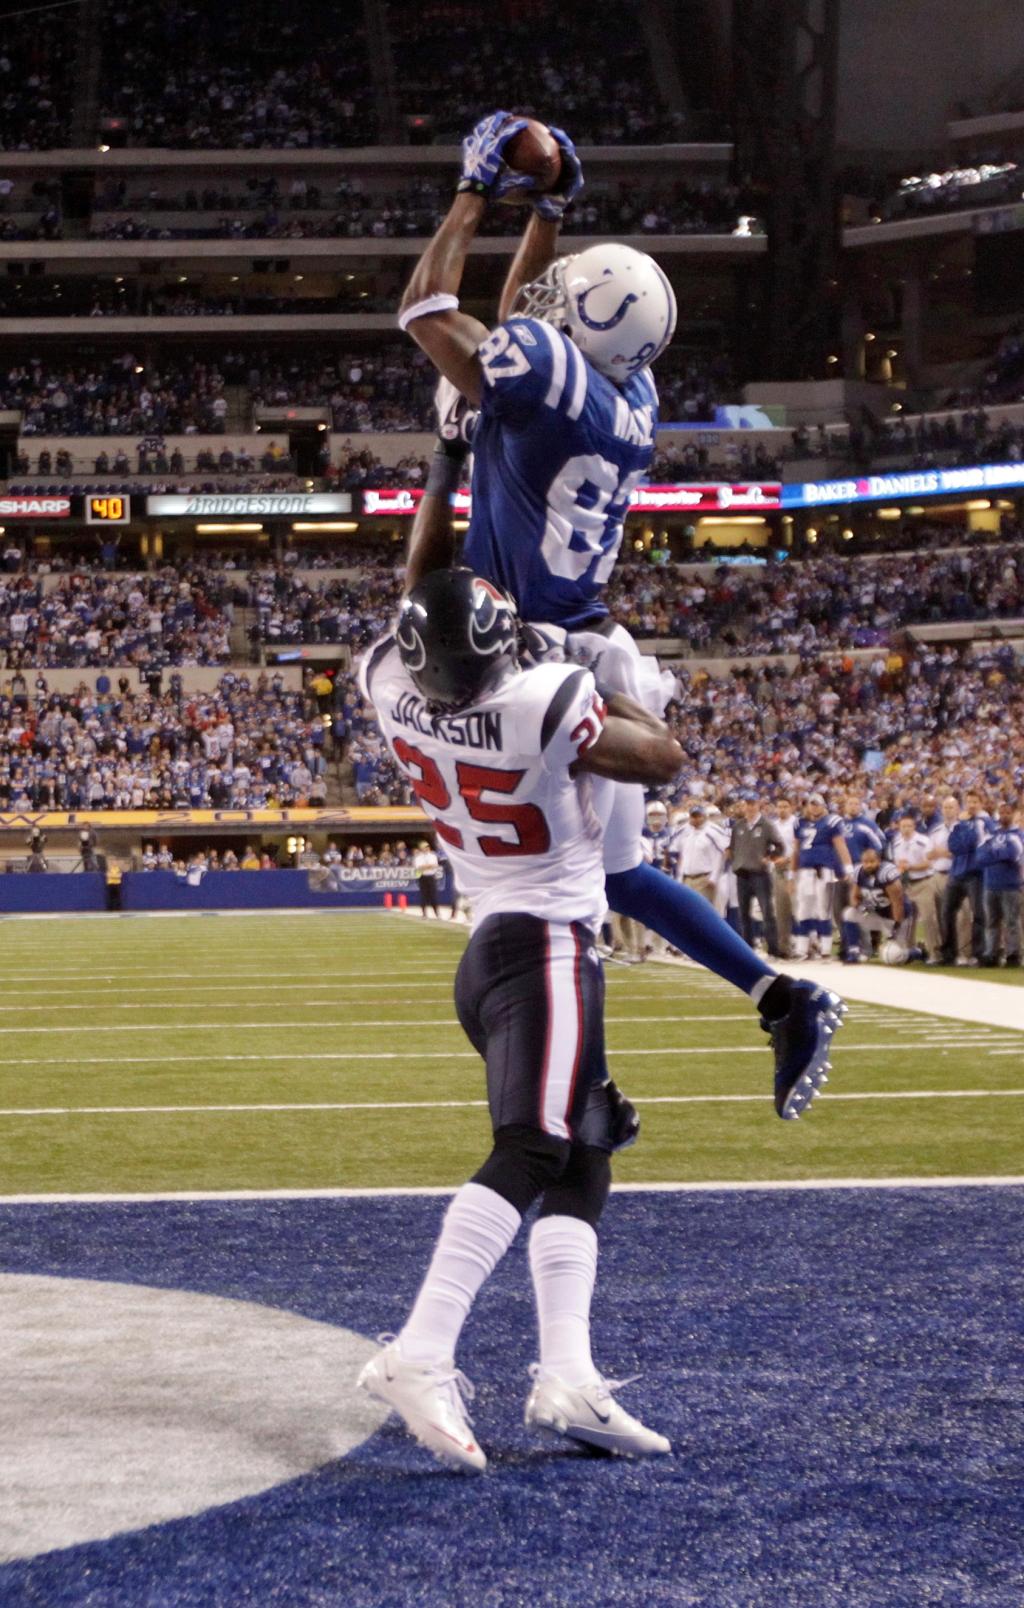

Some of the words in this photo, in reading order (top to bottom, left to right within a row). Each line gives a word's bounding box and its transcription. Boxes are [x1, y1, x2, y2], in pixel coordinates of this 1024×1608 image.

[478, 326, 531, 387] 87
[803, 482, 859, 503] BAKER
[869, 472, 938, 496] DANIELS
[0, 500, 71, 514] SHARP
[92, 497, 123, 519] 40
[186, 496, 314, 514] BRIDGESTONE
[391, 690, 503, 752] JACKSON
[392, 736, 551, 857] 25
[801, 829, 817, 849] 7
[341, 867, 444, 880] CALDWELS
